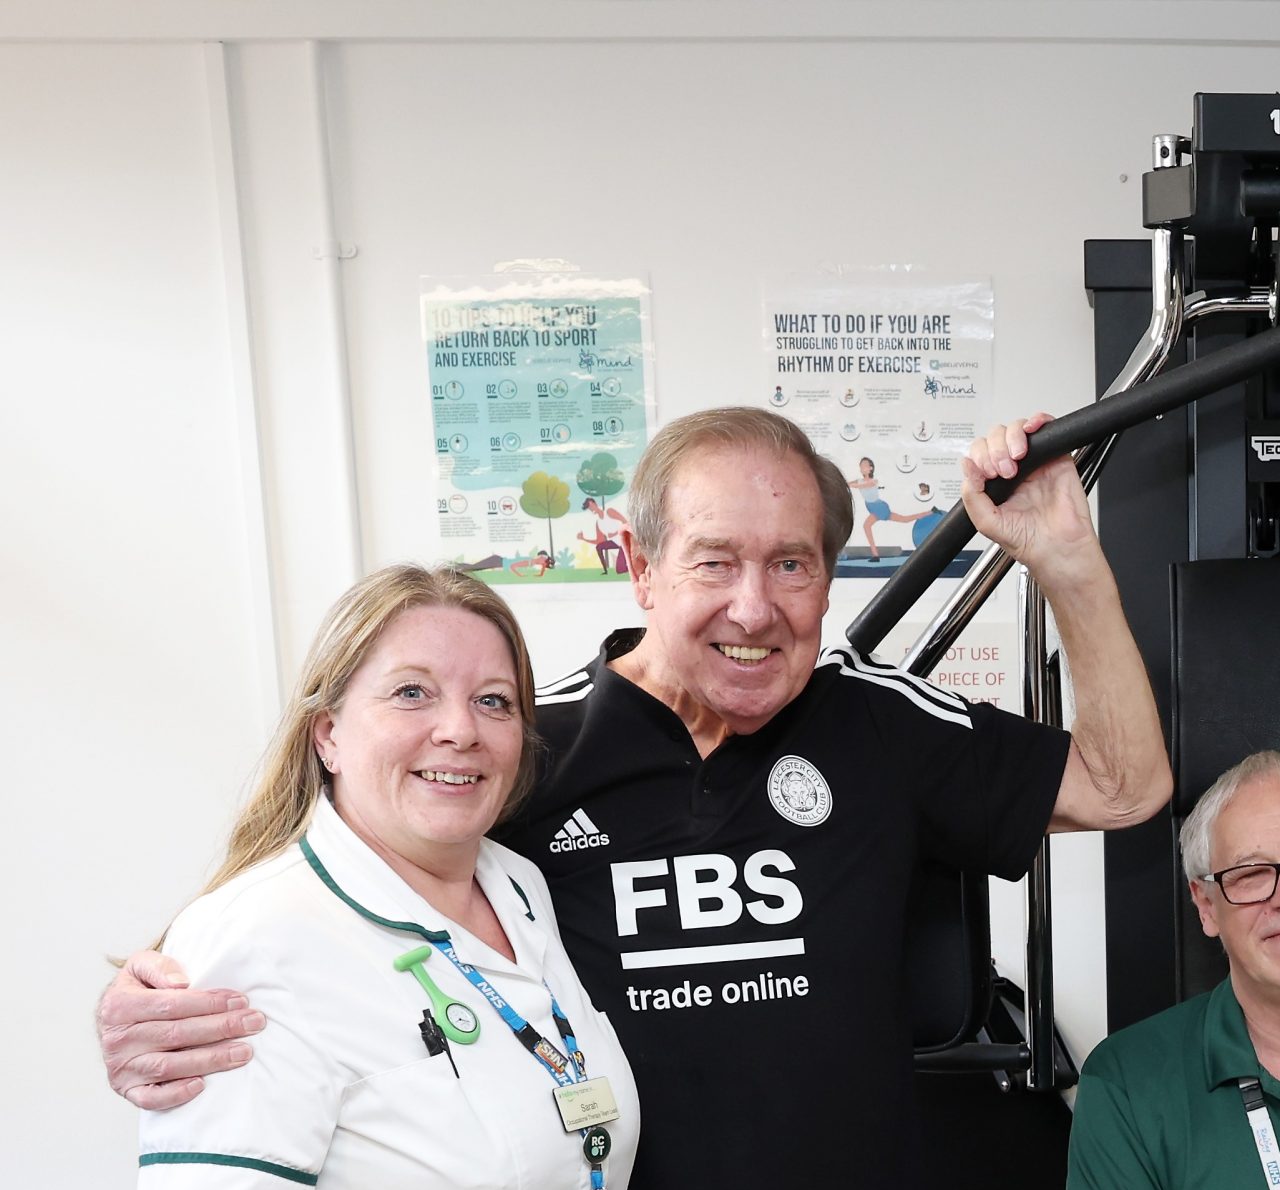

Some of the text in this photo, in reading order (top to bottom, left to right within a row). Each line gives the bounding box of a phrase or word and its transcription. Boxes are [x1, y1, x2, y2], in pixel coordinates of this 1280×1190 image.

[775, 314, 951, 334] WHAT TO DO IF YOU ARE
[435, 329, 598, 348] RETURN BACK TO SPORT
[776, 337, 951, 350] STRUGGLING TO GET BACK INTO THE
[435, 352, 517, 367] AND EXERCISE
[778, 356, 921, 373] RHYTHM OF EXERCISE
[944, 647, 999, 660] OT USE
[939, 673, 980, 685] PIECE
[985, 673, 1005, 685] OF
[774, 762, 823, 791] LEICESTER CITY
[775, 793, 826, 820] FOOTBALL CLUB
[549, 832, 610, 852] adidas
[610, 849, 803, 937] FBS
[477, 981, 506, 1009] NHS
[626, 972, 809, 1011] trade online
[542, 1043, 564, 1069] NHS
[581, 1102, 598, 1112] Sarah
[592, 1136, 605, 1146] RC
